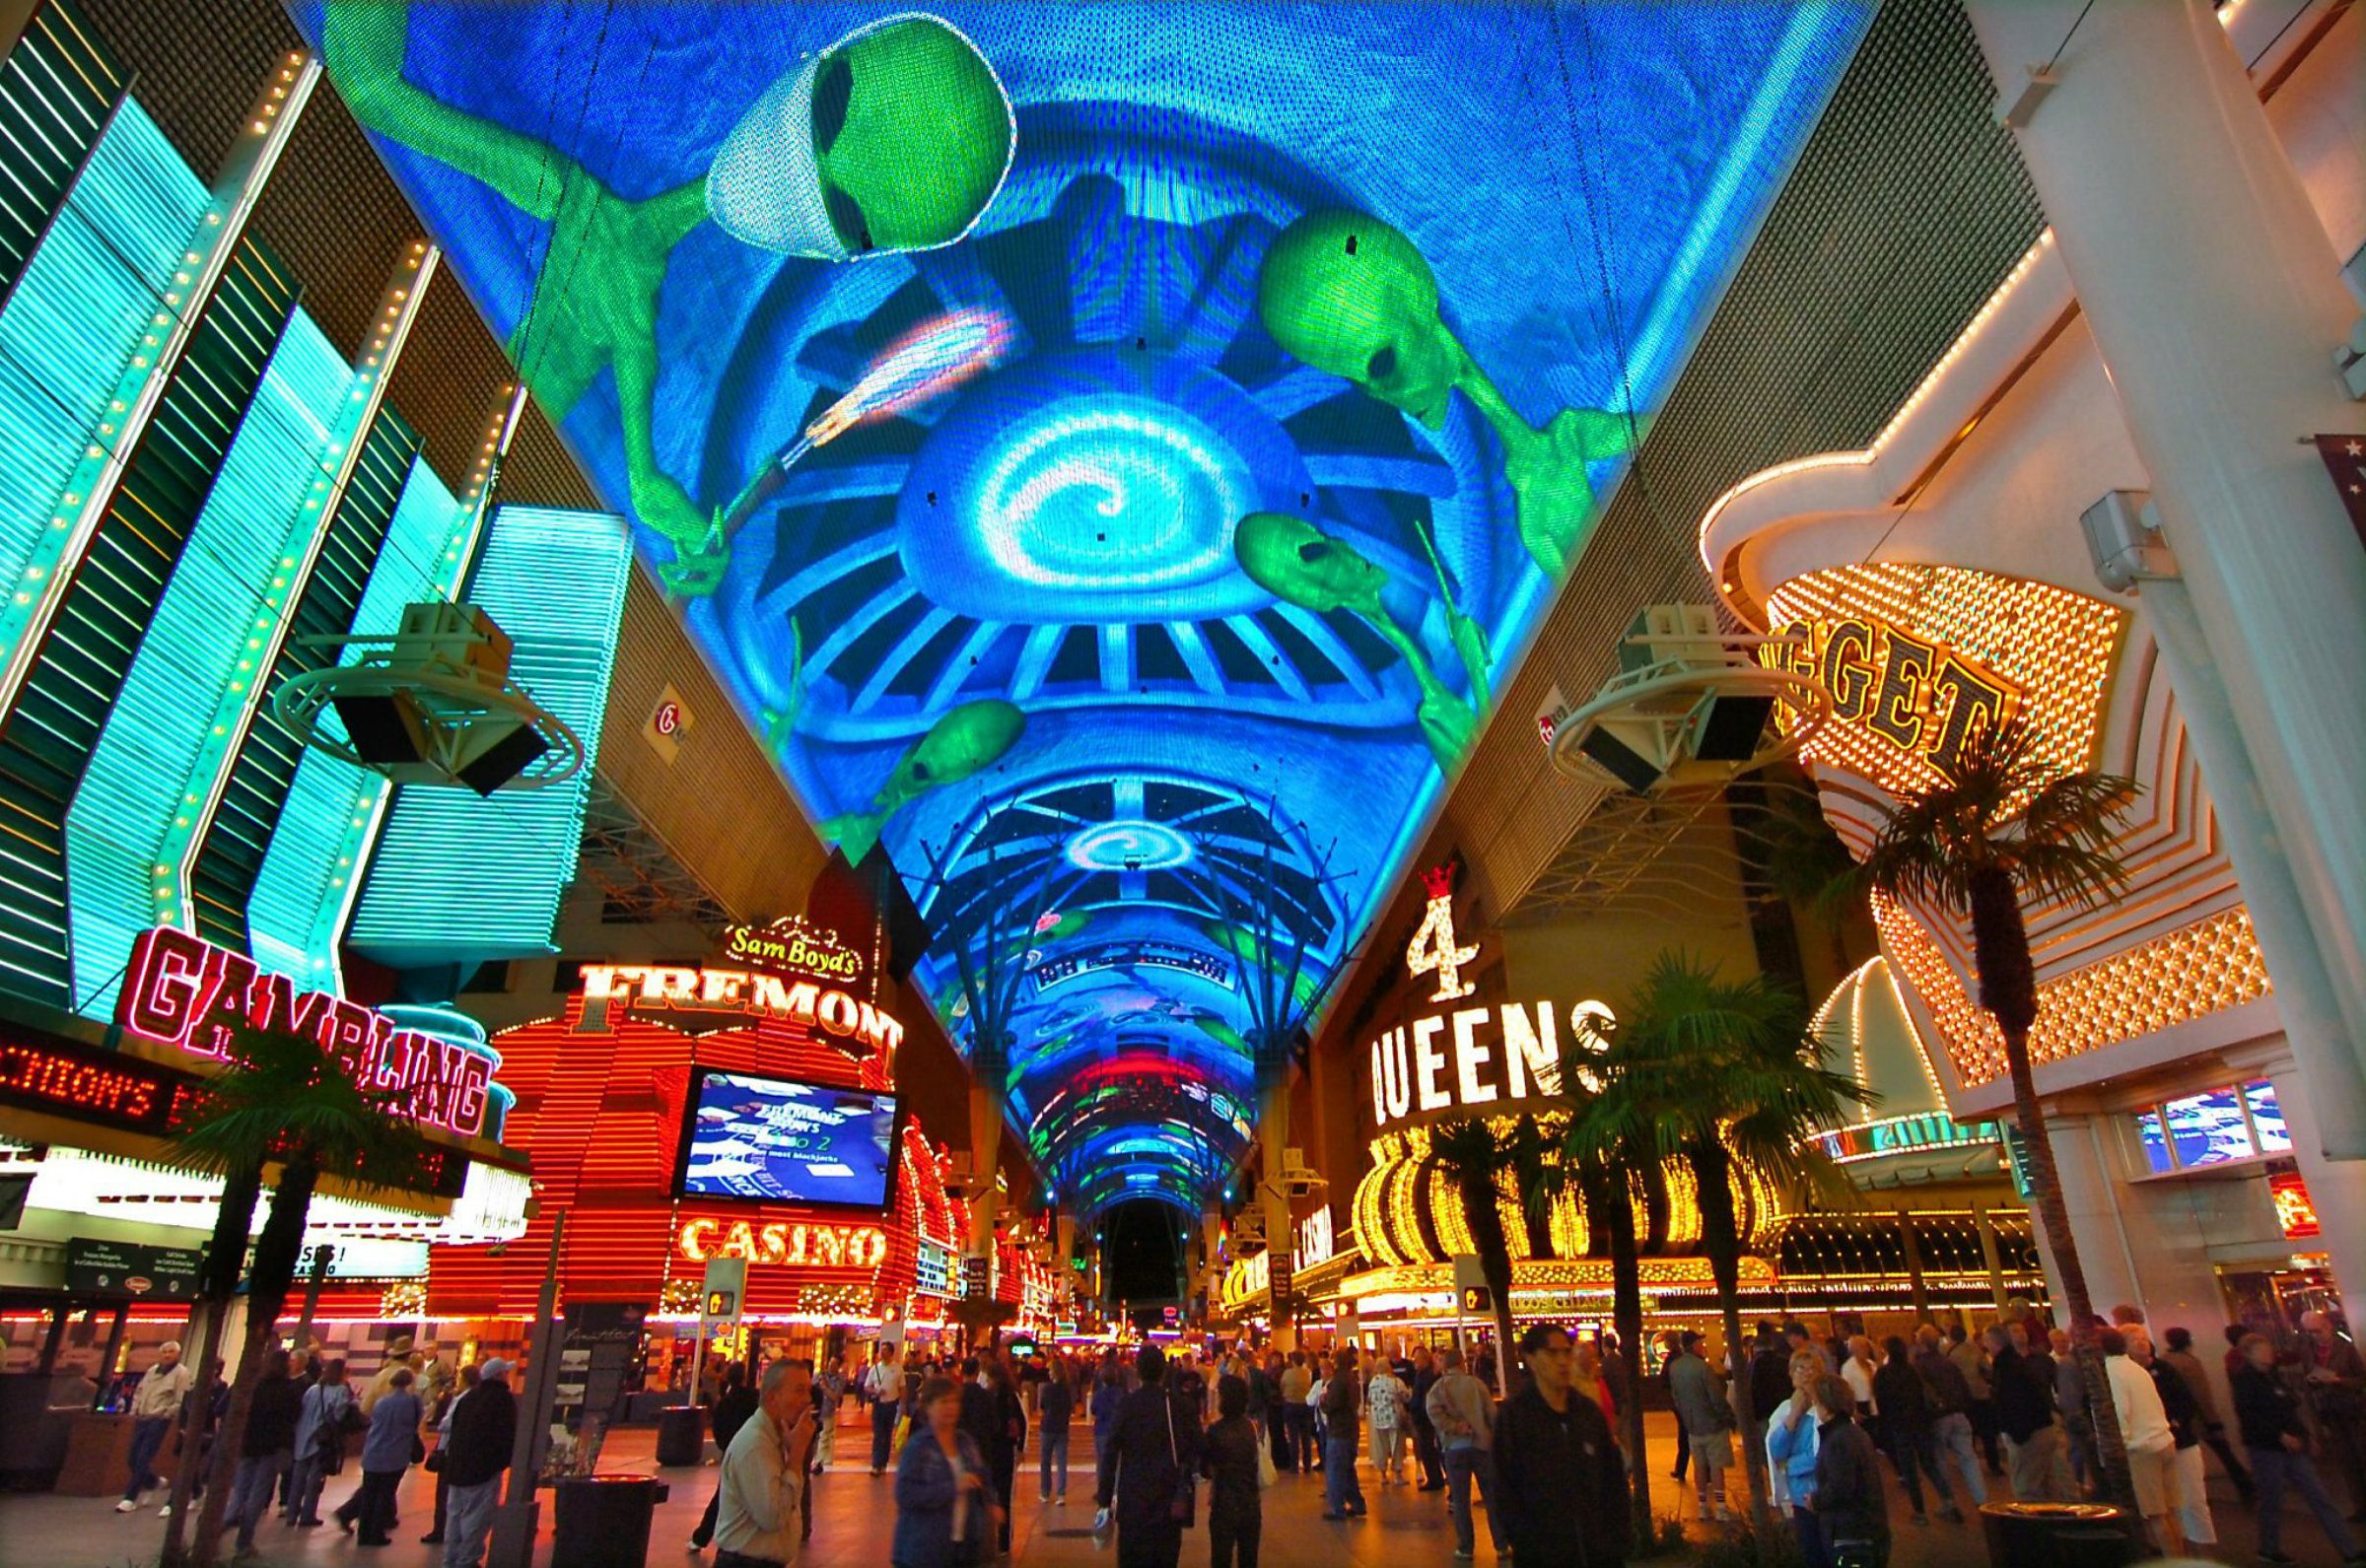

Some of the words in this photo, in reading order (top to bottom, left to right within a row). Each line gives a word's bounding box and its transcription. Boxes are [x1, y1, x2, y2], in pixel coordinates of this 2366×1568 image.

[1759, 619, 2006, 788] GGET
[731, 927, 785, 959] Sam
[788, 939, 855, 975] Boyd's
[1406, 894, 1481, 1003] 4
[569, 964, 904, 1076] FREMONT
[794, 1151, 838, 1163] blackjacks
[816, 1135, 831, 1151] 2
[678, 1217, 887, 1268] CASINO
